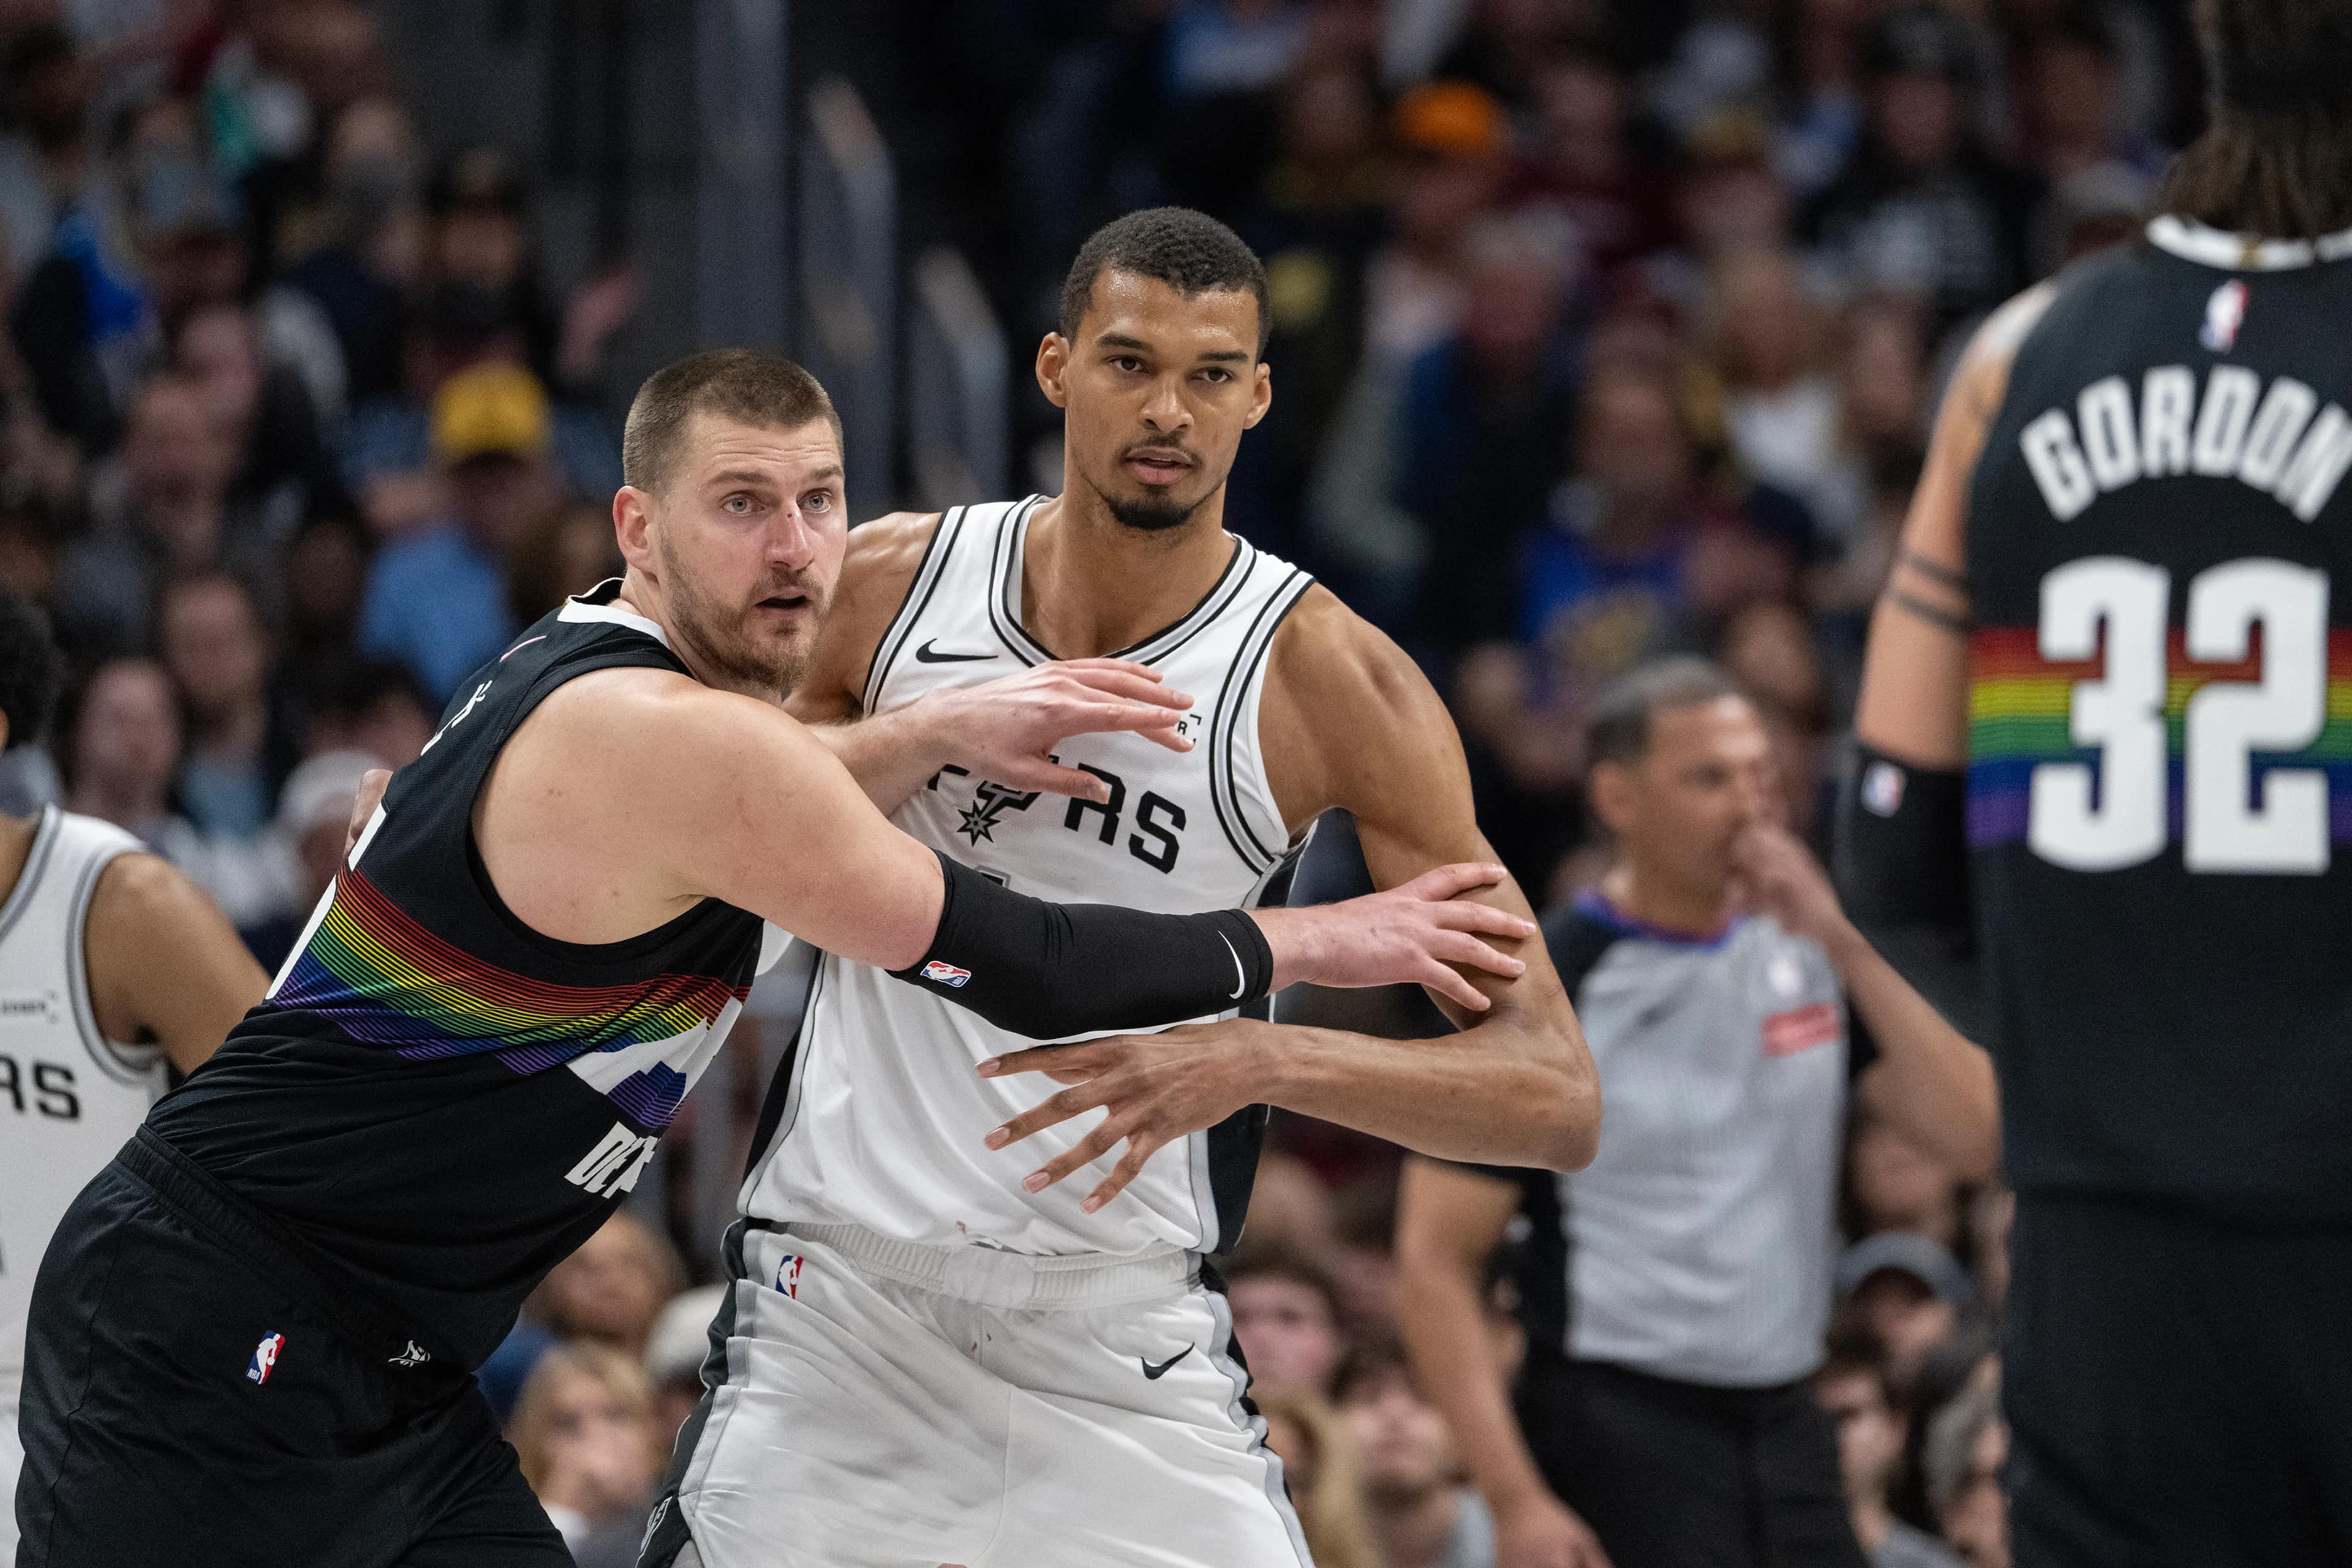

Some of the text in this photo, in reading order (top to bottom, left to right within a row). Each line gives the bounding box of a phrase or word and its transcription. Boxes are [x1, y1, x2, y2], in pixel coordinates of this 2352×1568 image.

[2020, 364, 2352, 524] GORDON
[2027, 555, 2330, 876] 32
[247, 1368, 260, 1381] NBA
